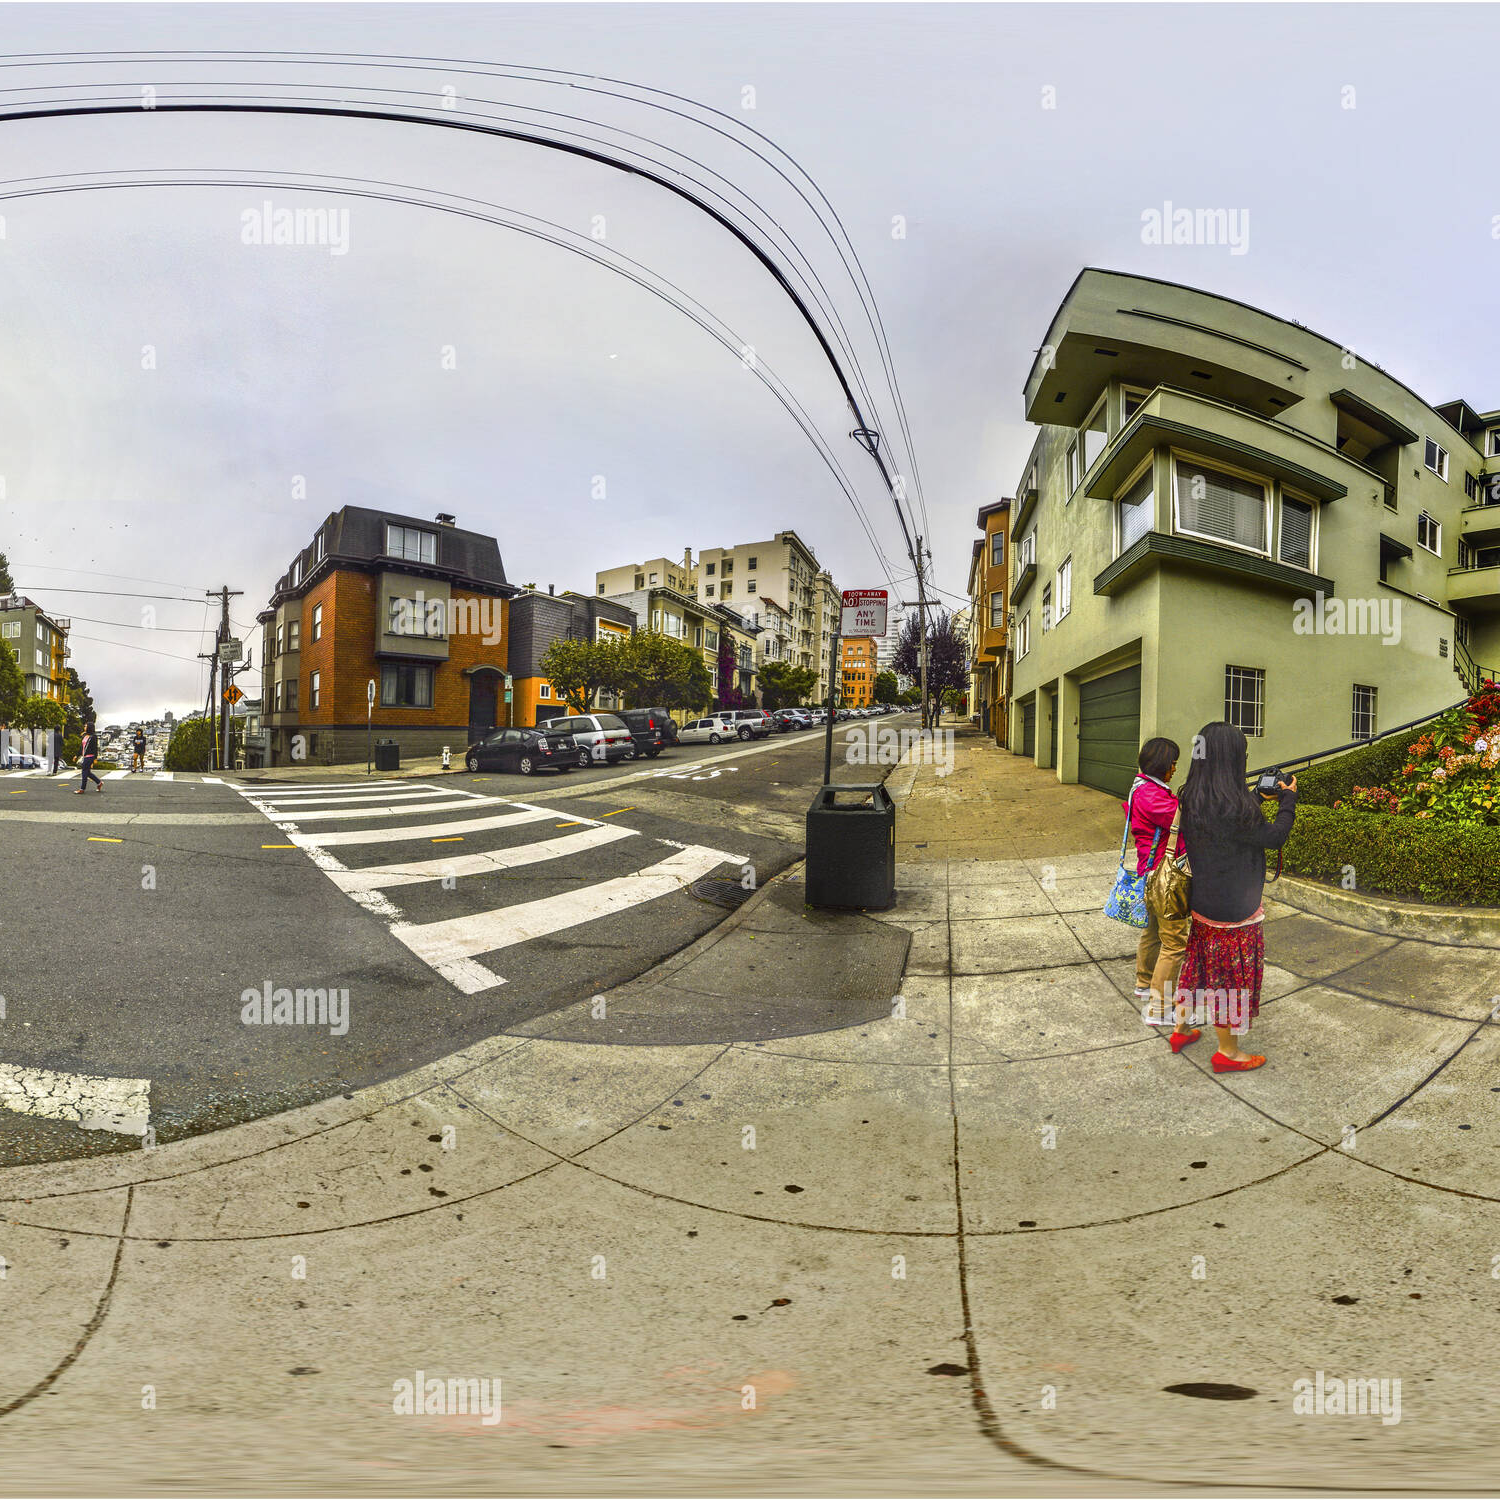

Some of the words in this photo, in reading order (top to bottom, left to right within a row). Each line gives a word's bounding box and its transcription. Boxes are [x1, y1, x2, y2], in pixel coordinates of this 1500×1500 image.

[860, 599, 886, 607] STOPPING
[856, 610, 875, 618] ANY
[855, 618, 877, 627] TIME
